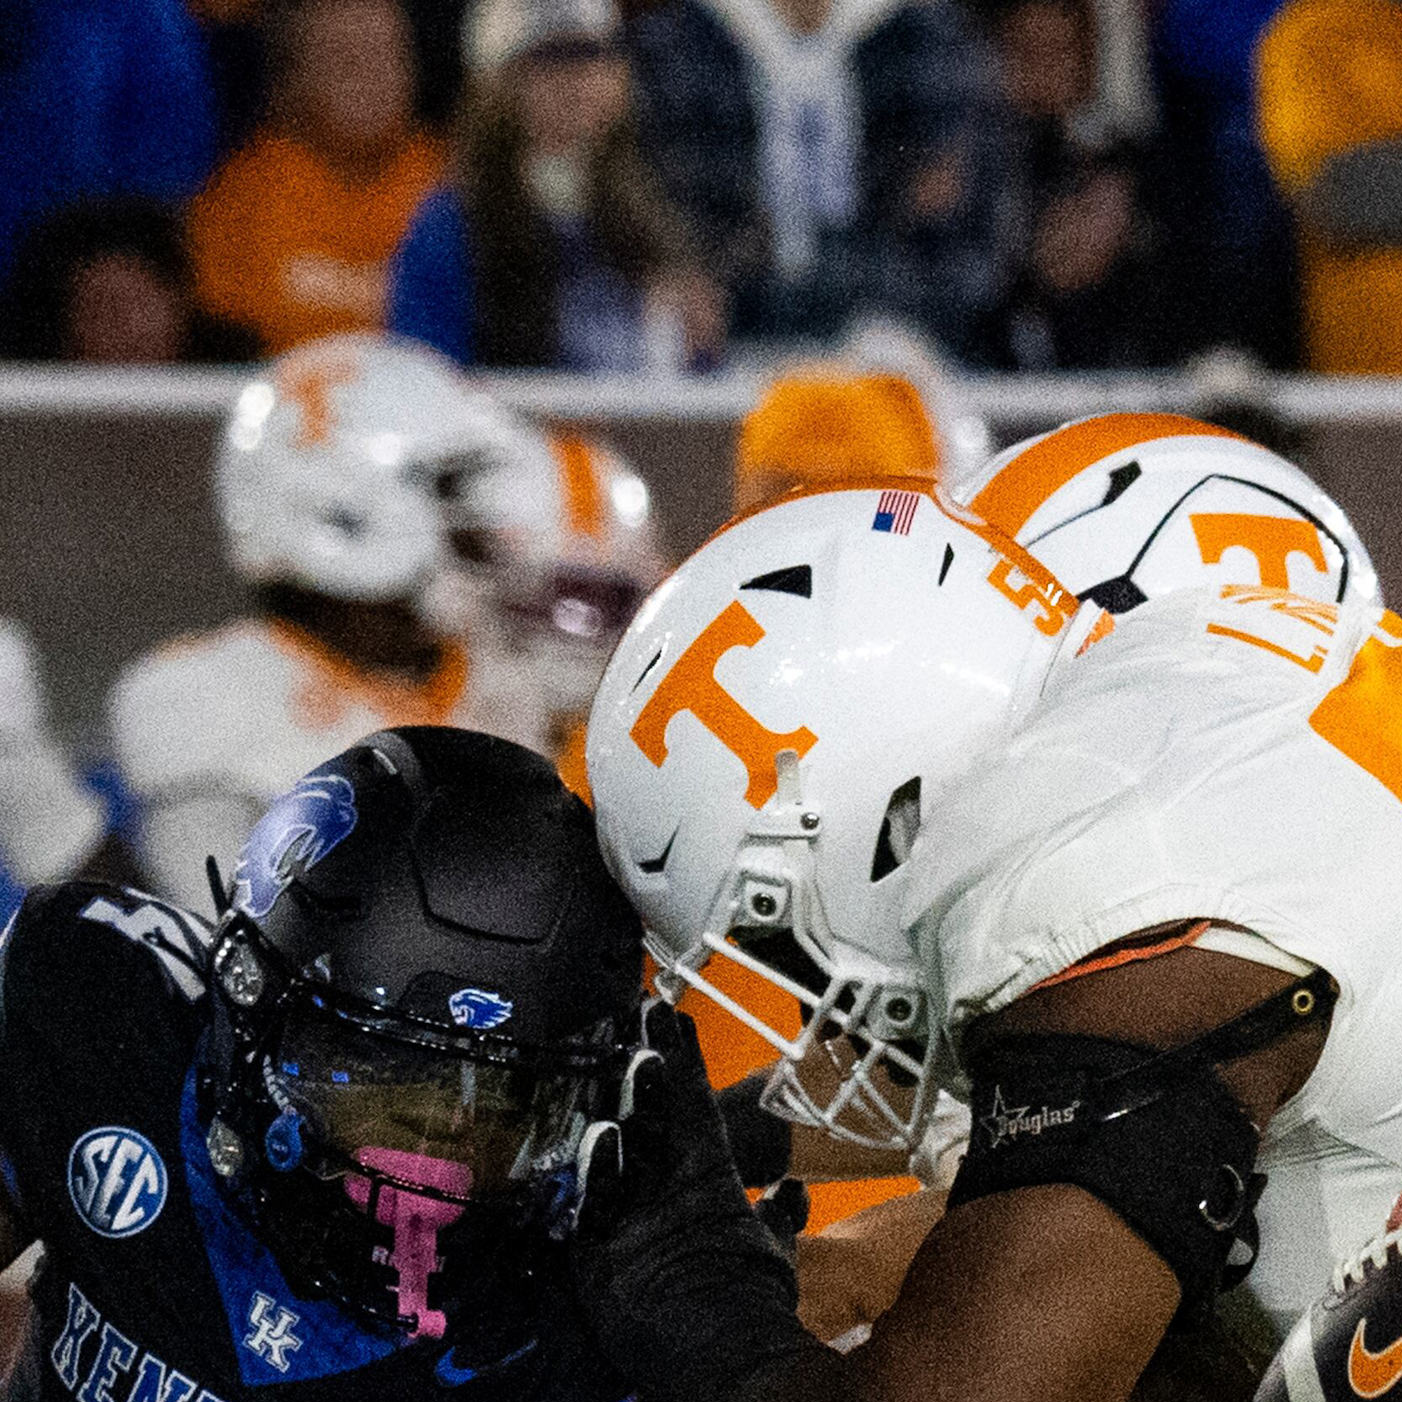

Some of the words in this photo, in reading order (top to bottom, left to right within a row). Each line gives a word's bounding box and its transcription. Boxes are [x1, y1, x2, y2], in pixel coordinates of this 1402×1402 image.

[1188, 513, 1330, 592] T
[629, 598, 819, 812] T
[70, 1134, 160, 1231] SEC
[242, 1290, 304, 1374] UK
